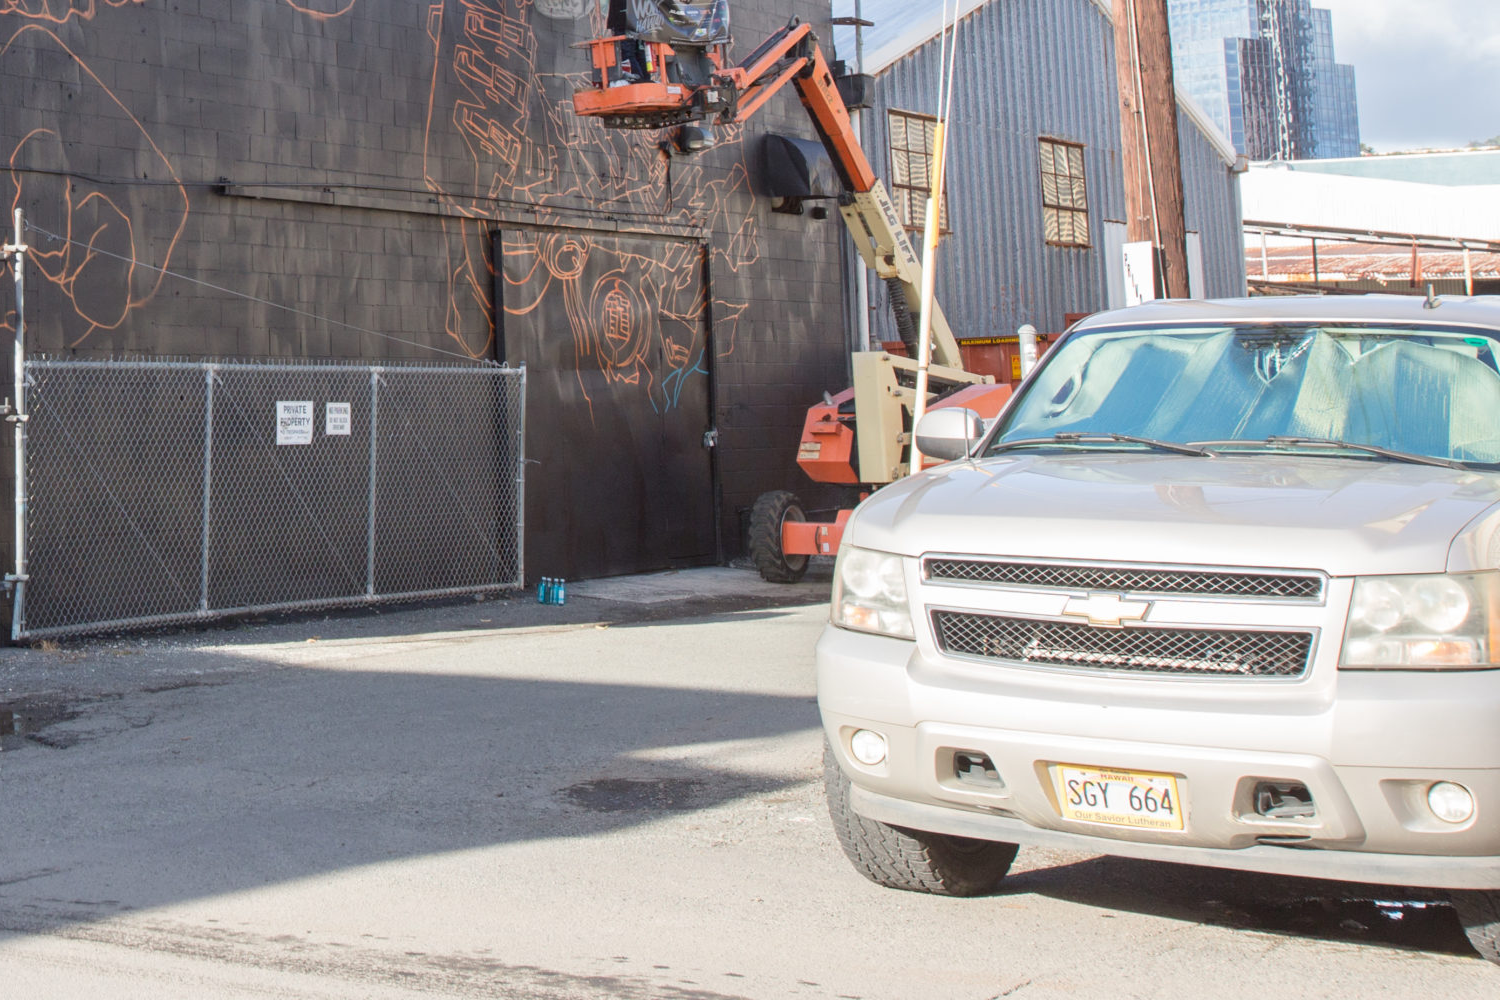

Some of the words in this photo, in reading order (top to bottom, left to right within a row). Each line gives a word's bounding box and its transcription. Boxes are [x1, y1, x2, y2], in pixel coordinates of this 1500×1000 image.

[879, 199, 898, 227] JLG
[894, 230, 916, 264] LIFT
[283, 405, 307, 414] PRIVATE
[280, 417, 311, 427] PROPERTY
[1067, 780, 1110, 809] SGY
[1128, 785, 1174, 815] 664
[1074, 810, 1093, 820] Our
[1094, 812, 1126, 824] Savior
[1127, 814, 1172, 829] Lutheran
